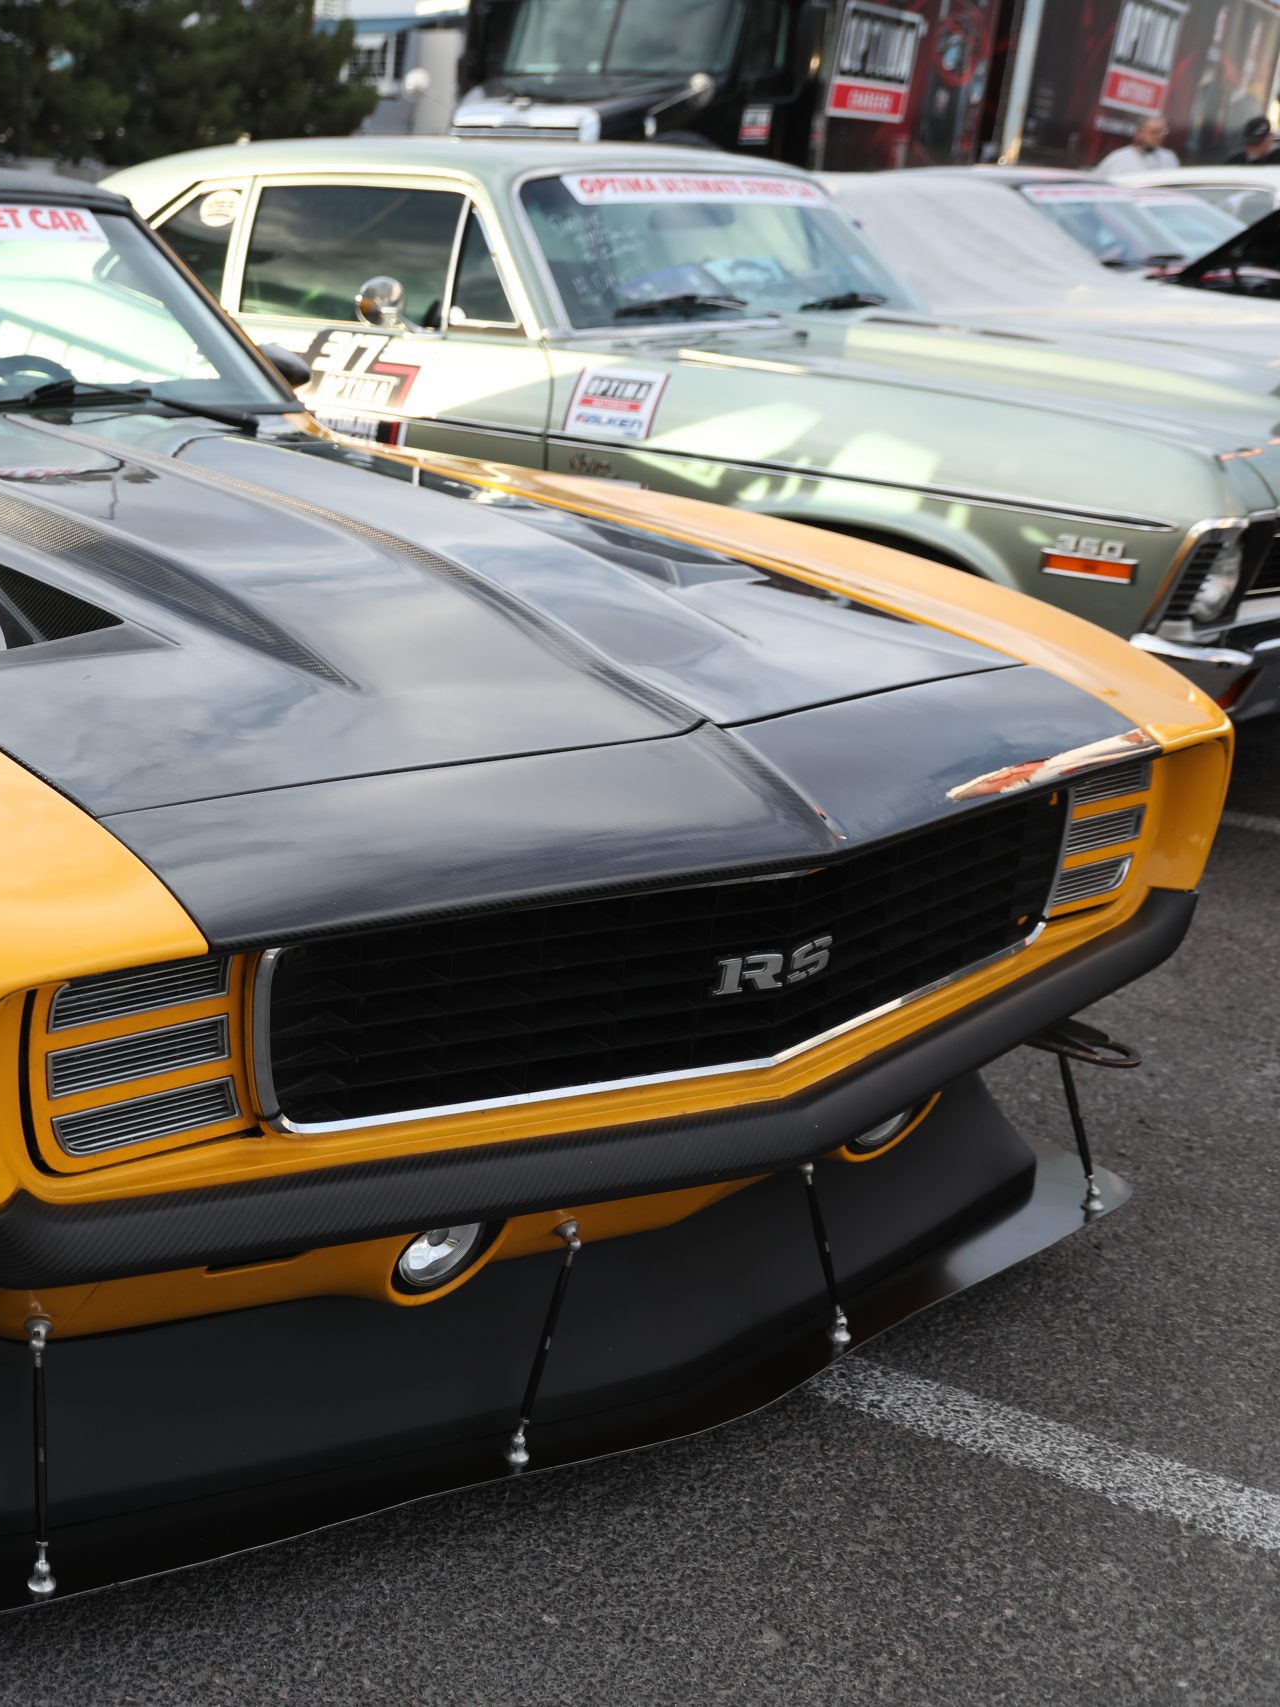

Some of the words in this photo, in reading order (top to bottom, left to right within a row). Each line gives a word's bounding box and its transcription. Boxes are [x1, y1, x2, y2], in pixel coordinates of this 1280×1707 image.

[578, 176, 658, 195] OPTIMA
[28, 209, 90, 232] CAR
[585, 377, 651, 401] OPTIMA
[1055, 532, 1125, 559] 350
[712, 935, 833, 996] RS
